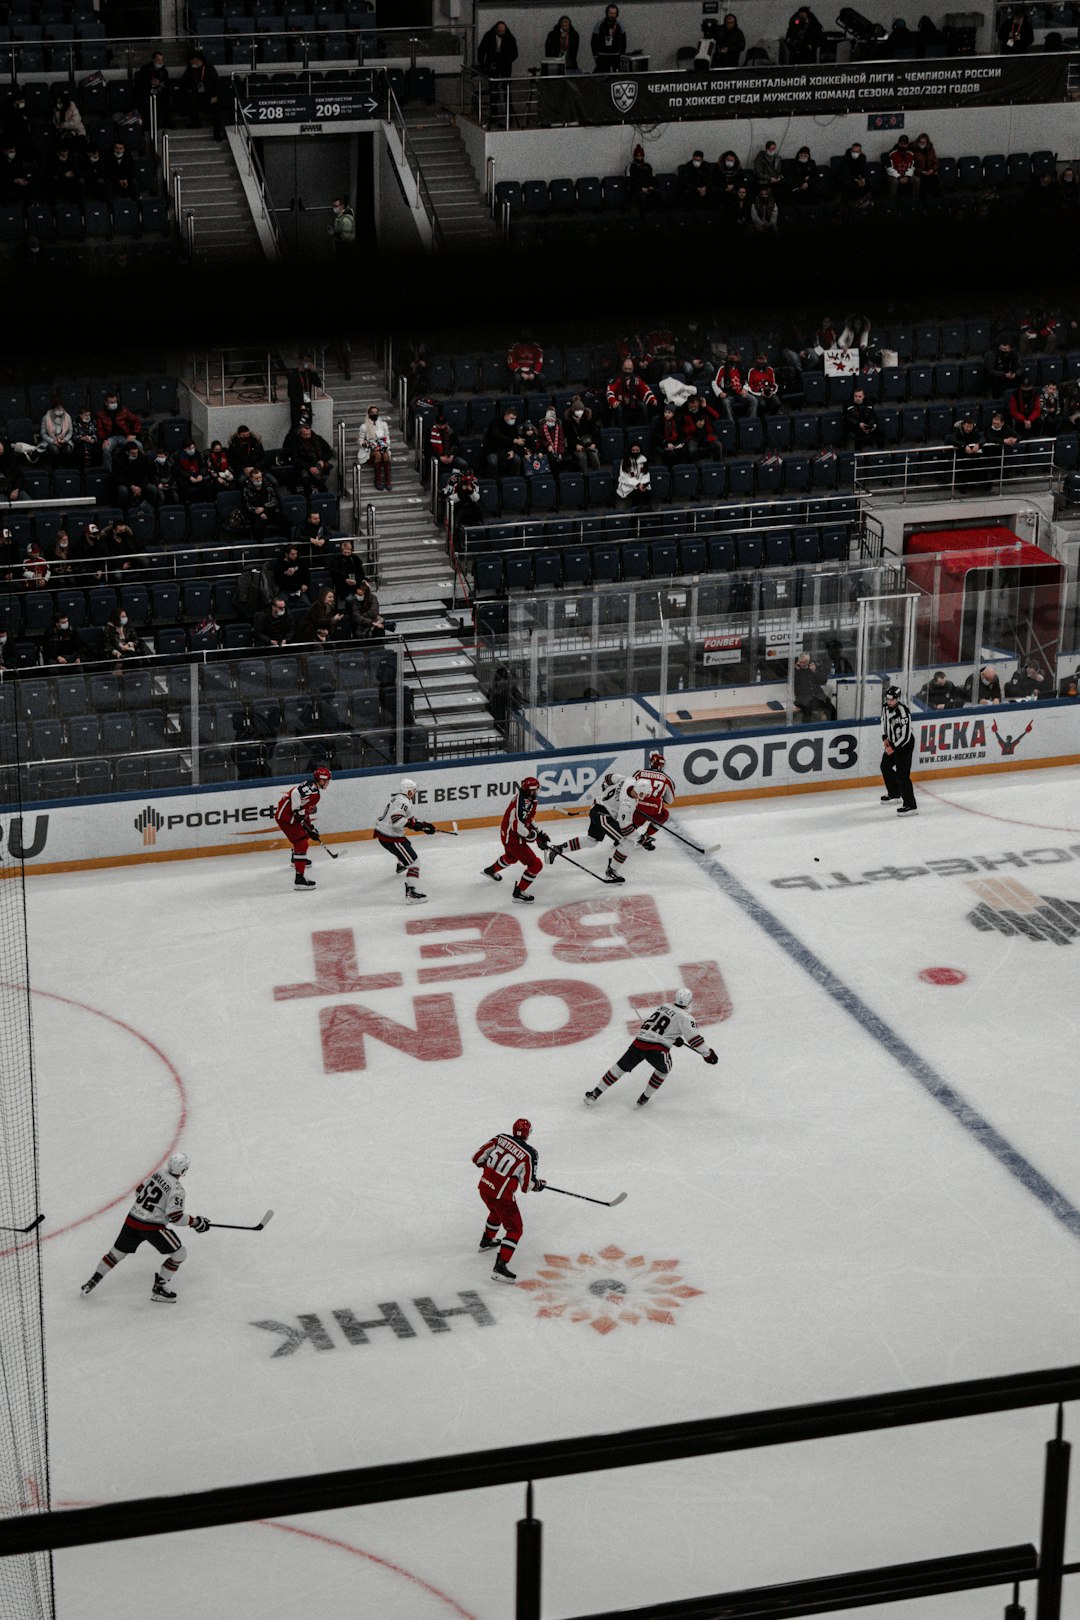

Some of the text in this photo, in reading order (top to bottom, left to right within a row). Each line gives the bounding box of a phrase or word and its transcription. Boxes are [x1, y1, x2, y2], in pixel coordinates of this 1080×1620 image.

[647, 81, 707, 94] ЧЕМПИОНАТ
[710, 75, 806, 91] КОНТИНЕНТАЛЬНОЙ
[808, 71, 866, 86] ХОККЕЙНОЙ
[868, 72, 895, 84] ЛИГИ
[904, 70, 963, 82] ЧЕМПИОНАТ
[965, 68, 1002, 79] РОССИИ
[668, 83, 980, 108] ПО ХОККЕЮ СРЕДИ МУЖСКИХ КОМАНД СЕЗОНА 2020/2021 ГОДОВ
[258, 106, 284, 120] 208
[315, 104, 341, 118] 209
[704, 637, 740, 649] FONBET
[919, 719, 987, 755] ЦСКА
[918, 751, 987, 766] WWW.CSKA-HOCKEY.RU
[434, 782, 483, 803] BEST
[536, 766, 598, 798] SAP
[167, 804, 275, 831] РОСНЕФ
[769, 844, 1080, 892] СНЕФТЬ
[273, 894, 672, 1002] BET
[641, 1011, 671, 1036] 28
[485, 1144, 517, 1178] 50
[135, 1180, 163, 1213] 52
